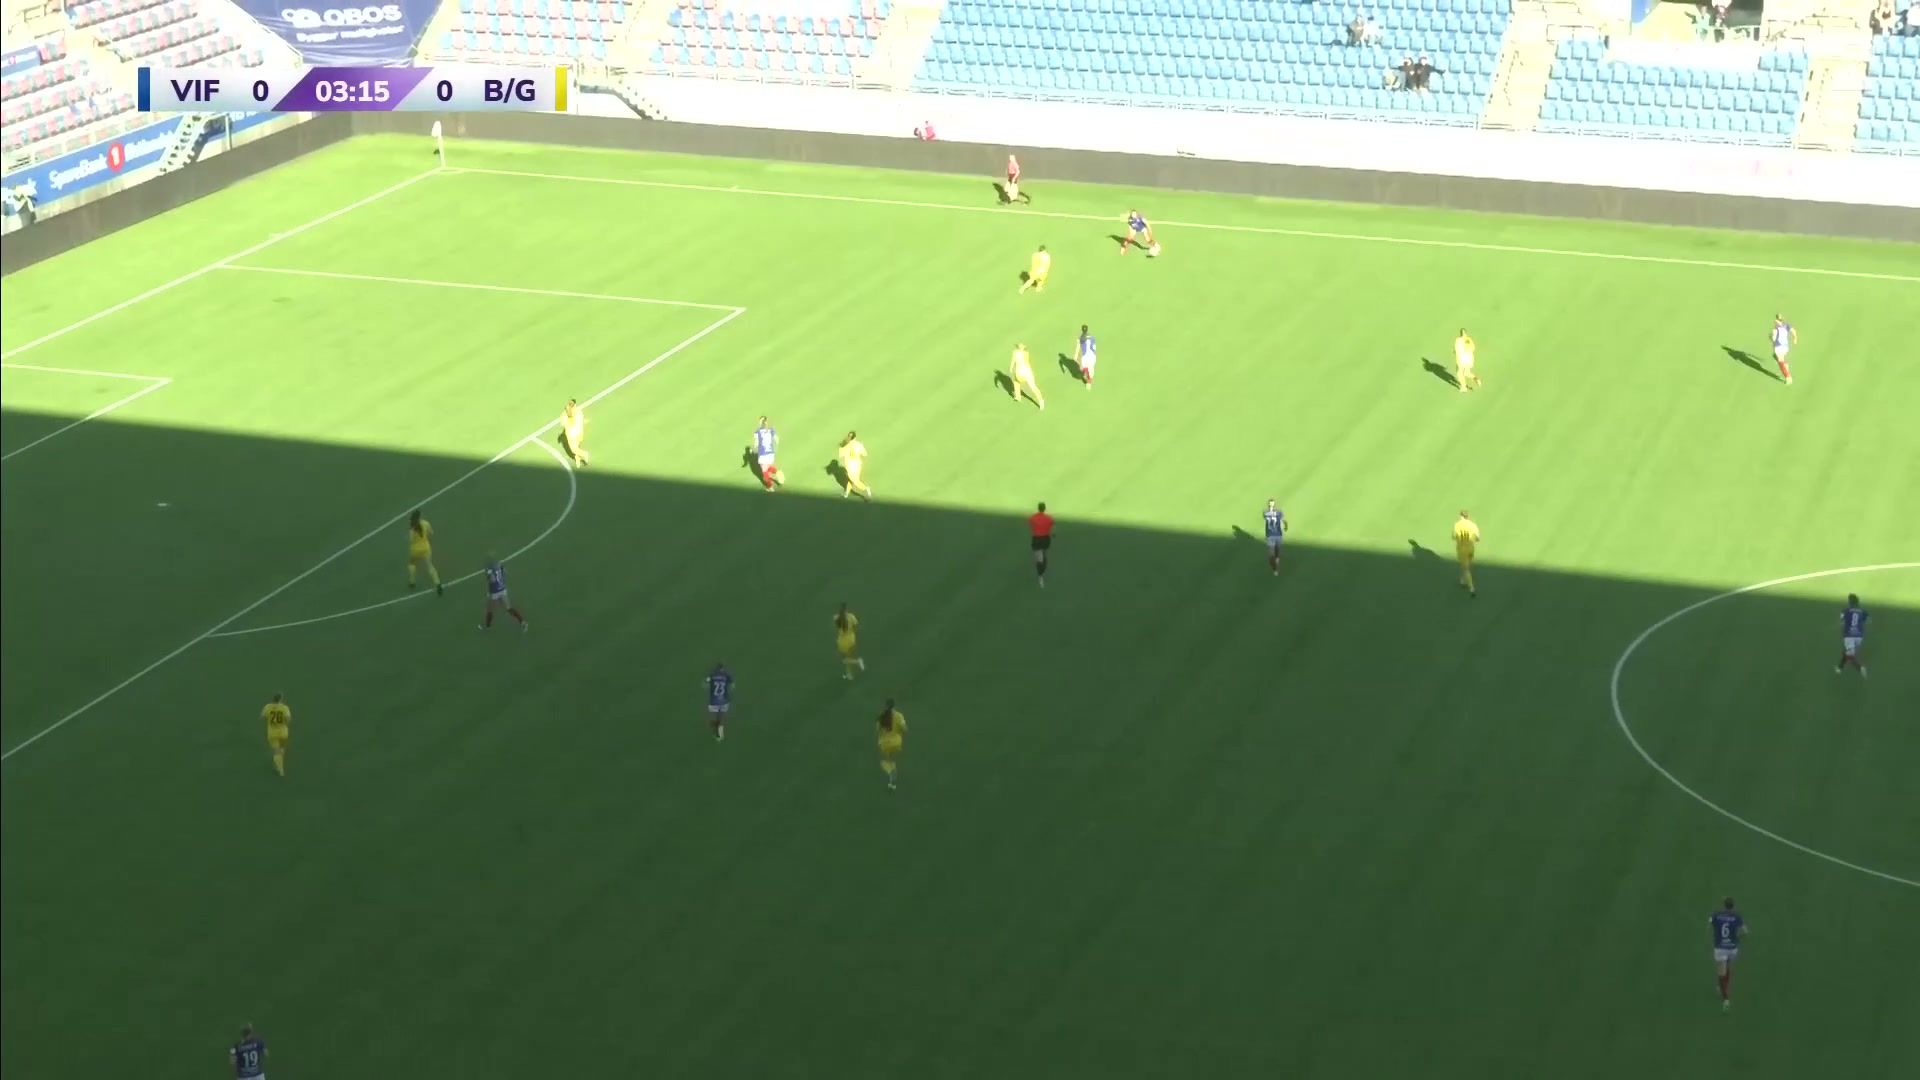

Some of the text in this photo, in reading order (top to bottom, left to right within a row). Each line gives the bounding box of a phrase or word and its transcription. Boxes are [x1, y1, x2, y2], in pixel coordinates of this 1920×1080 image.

[324, 5, 402, 25] OBOS
[1721, 922, 1730, 938] 6
[242, 1050, 258, 1067] 19
